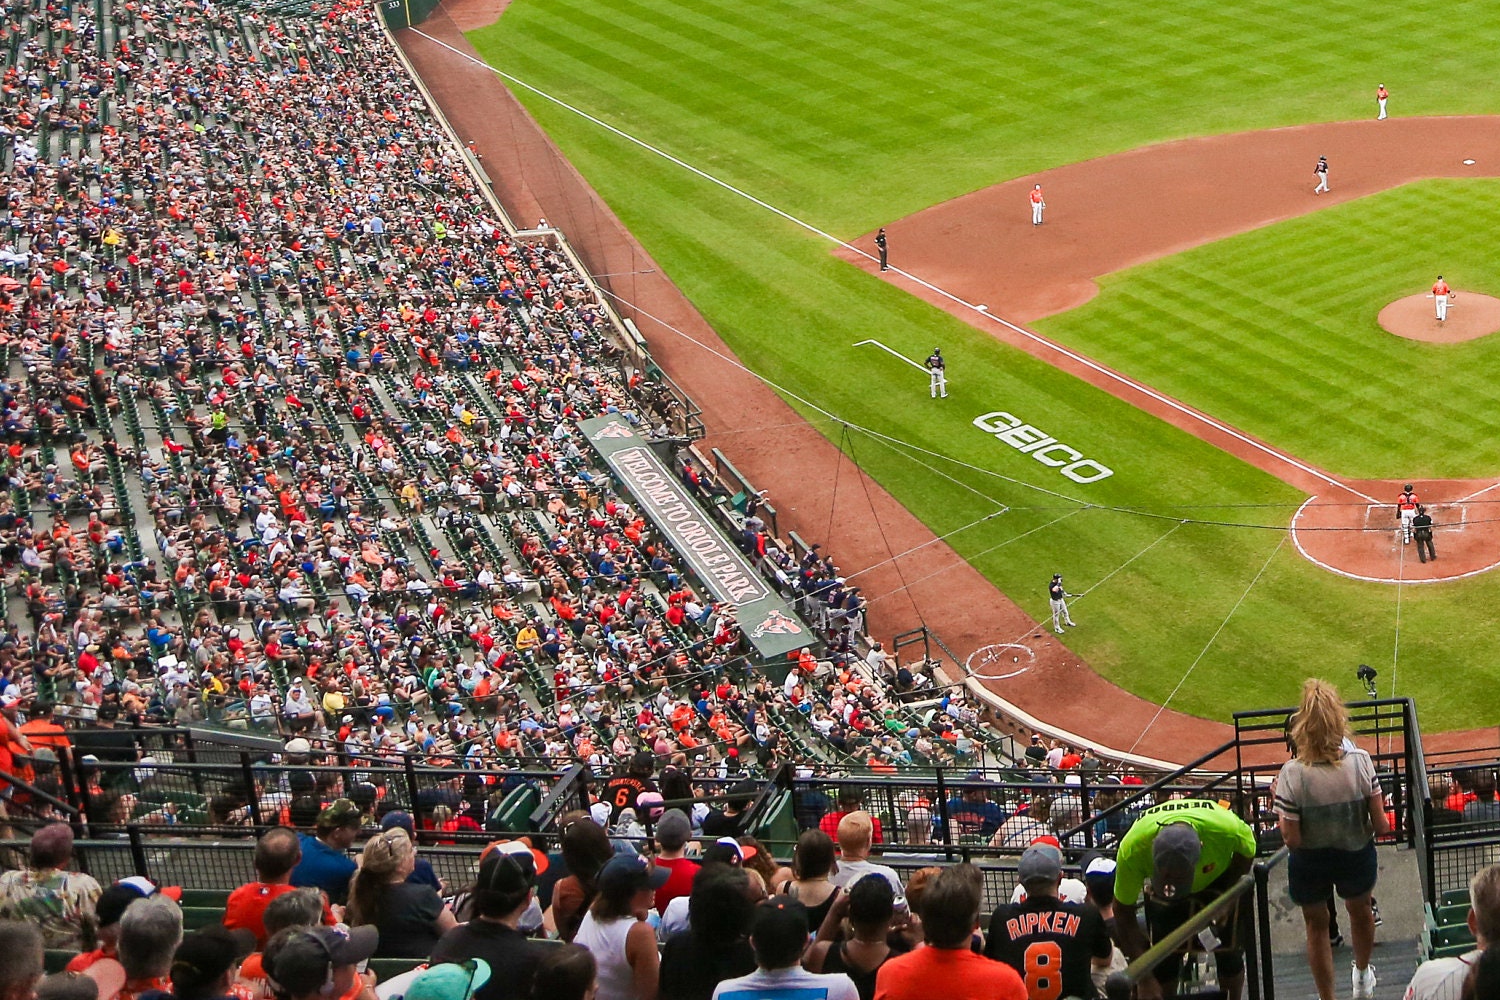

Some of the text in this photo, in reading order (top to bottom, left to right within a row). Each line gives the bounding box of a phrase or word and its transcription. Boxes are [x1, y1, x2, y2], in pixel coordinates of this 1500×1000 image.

[973, 411, 1114, 484] GEICO
[618, 450, 760, 601] WELCOME TO ORIOLE PARK
[615, 787, 630, 807] 6
[1006, 911, 1081, 941] RIPKEN
[1023, 941, 1063, 1000] 8
